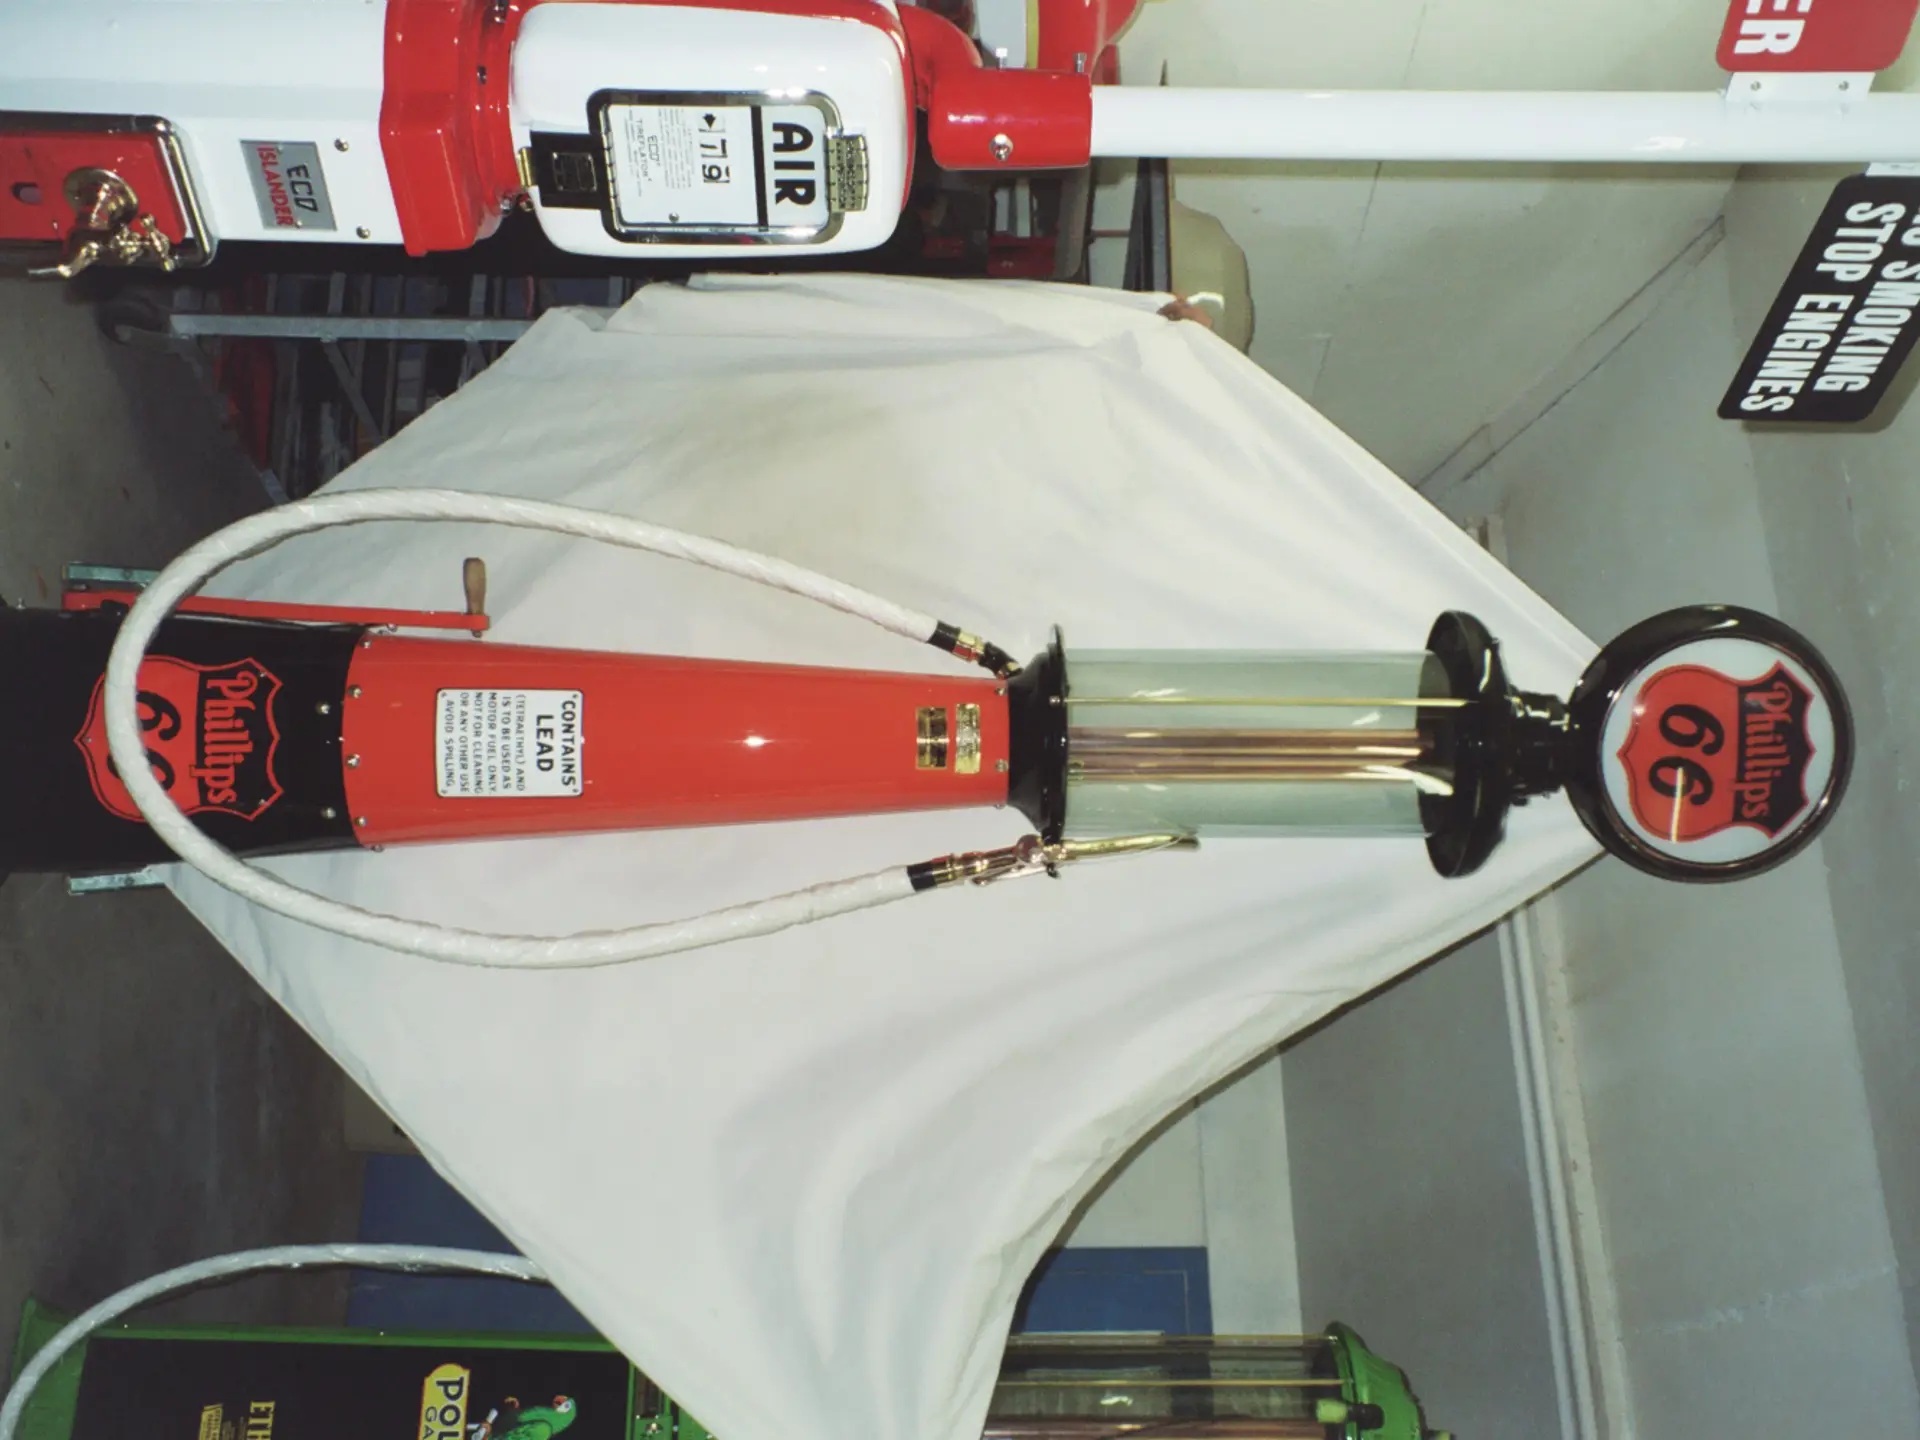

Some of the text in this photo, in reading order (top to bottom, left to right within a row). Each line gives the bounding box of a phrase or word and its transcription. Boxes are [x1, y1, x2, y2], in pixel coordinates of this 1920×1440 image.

[257, 146, 293, 226] ISLANDER
[287, 164, 318, 212] ECO
[772, 123, 816, 206] AIR
[1739, 202, 1906, 412] STOP ENGINES
[1813, 261, 1920, 392] SMOKING
[189, 671, 258, 804] Phillips
[445, 700, 455, 733] AVOID
[459, 692, 469, 792] OR ANY OTHER USE
[473, 692, 483, 794] NOT FOR CLEANING
[487, 734, 496, 760] FUEL
[488, 692, 496, 729] MOTOR
[502, 696, 511, 789] IS TO BE USED AS
[515, 694, 526, 791] (TETRAETHYL) AND
[536, 715, 554, 772] LEAD
[562, 701, 576, 786] CONTAINS
[1728, 682, 1792, 819] Phillips
[1649, 704, 1725, 806] 66
[246, 1400, 275, 1440] ETH
[423, 1406, 437, 1440] GA
[436, 1376, 464, 1440] POL
